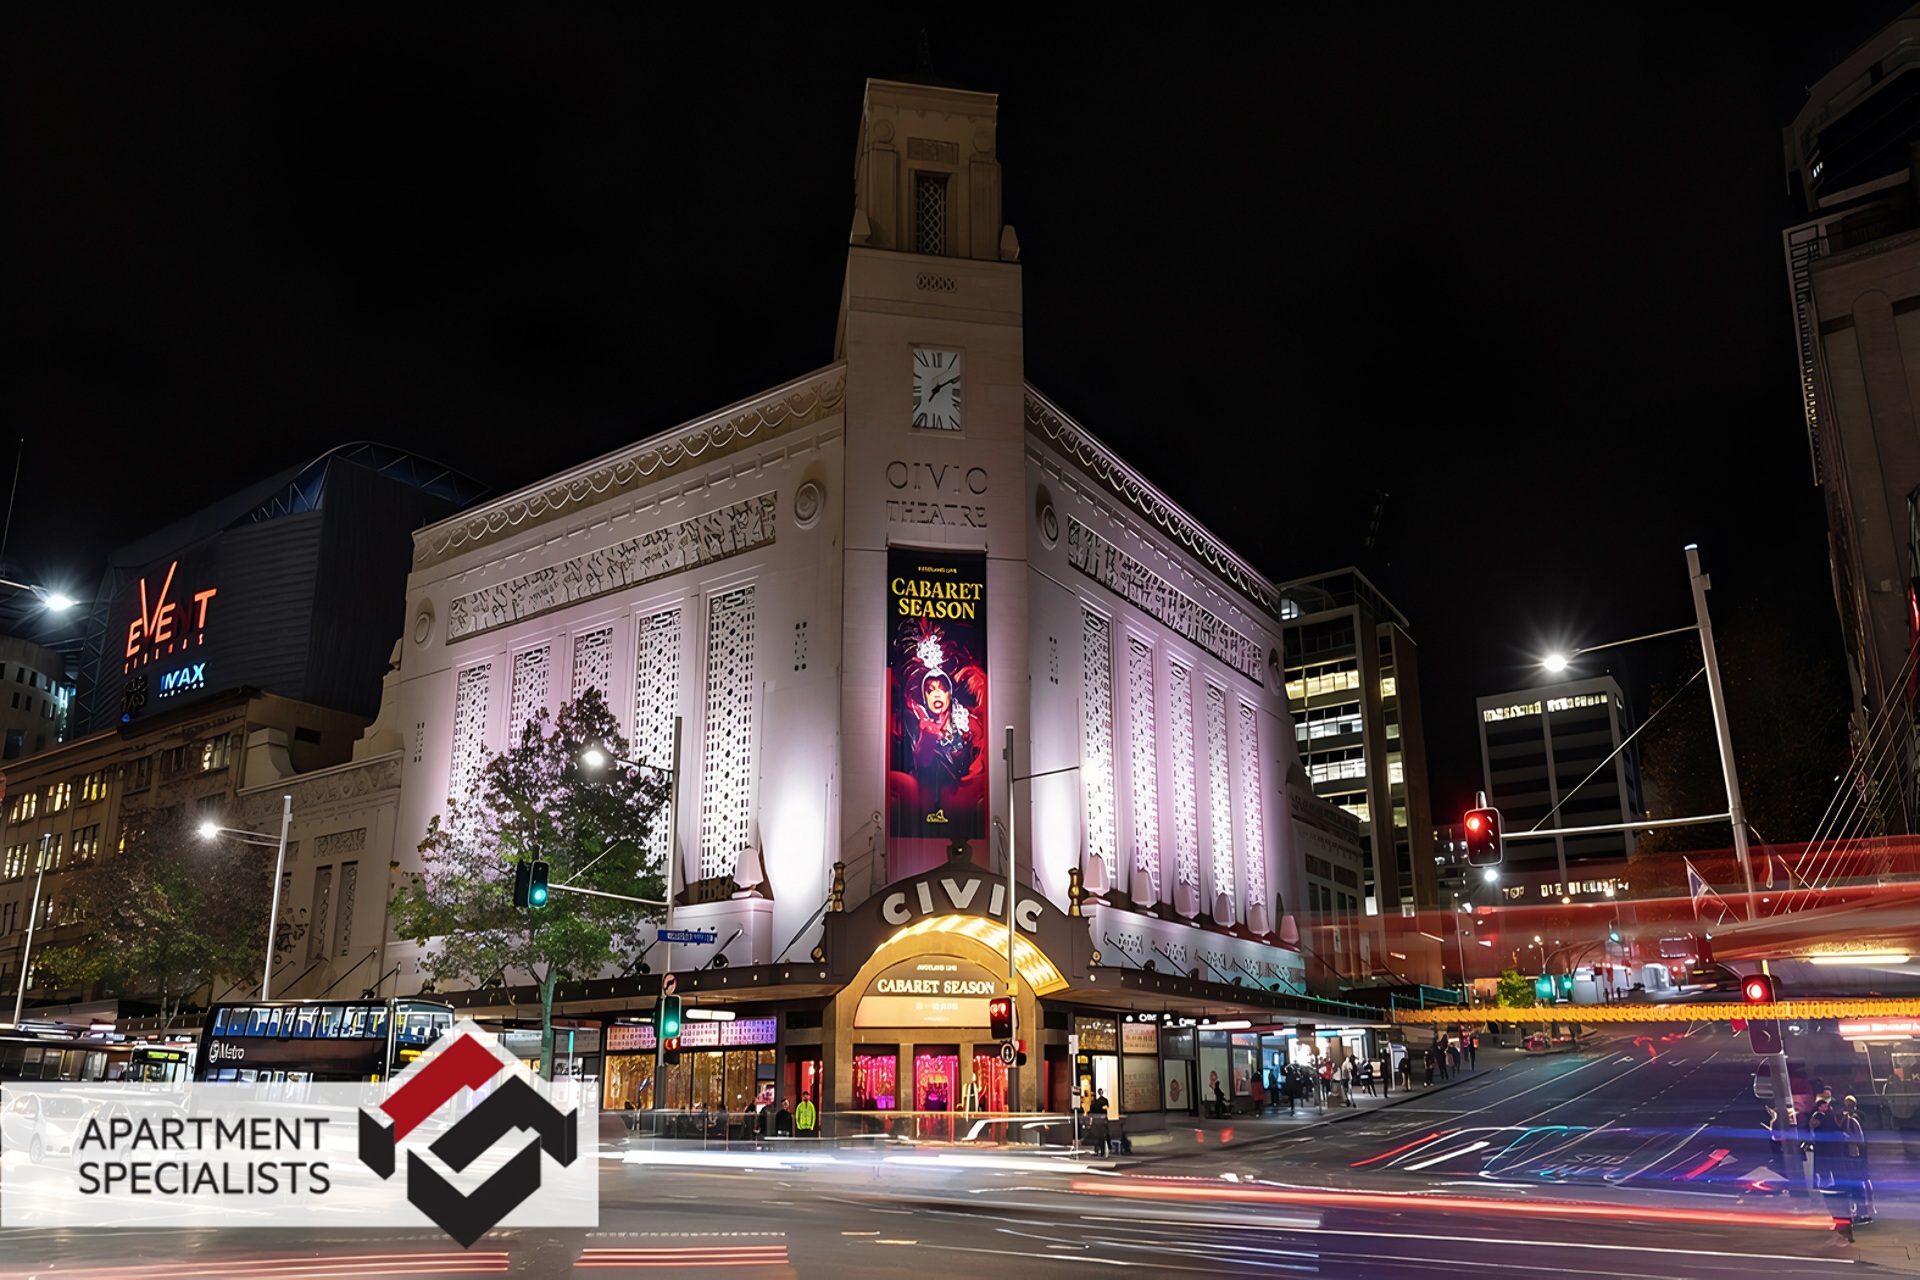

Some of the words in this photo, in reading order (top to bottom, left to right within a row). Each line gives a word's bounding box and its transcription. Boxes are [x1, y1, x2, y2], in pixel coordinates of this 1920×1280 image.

[886, 499, 988, 528] THEATRE
[891, 577, 984, 600] CABARET
[898, 597, 975, 620] SEASON
[160, 662, 206, 691] IMAX
[882, 878, 1043, 934] CIVIC
[877, 979, 940, 994] CABARET
[943, 980, 995, 995] SEASON
